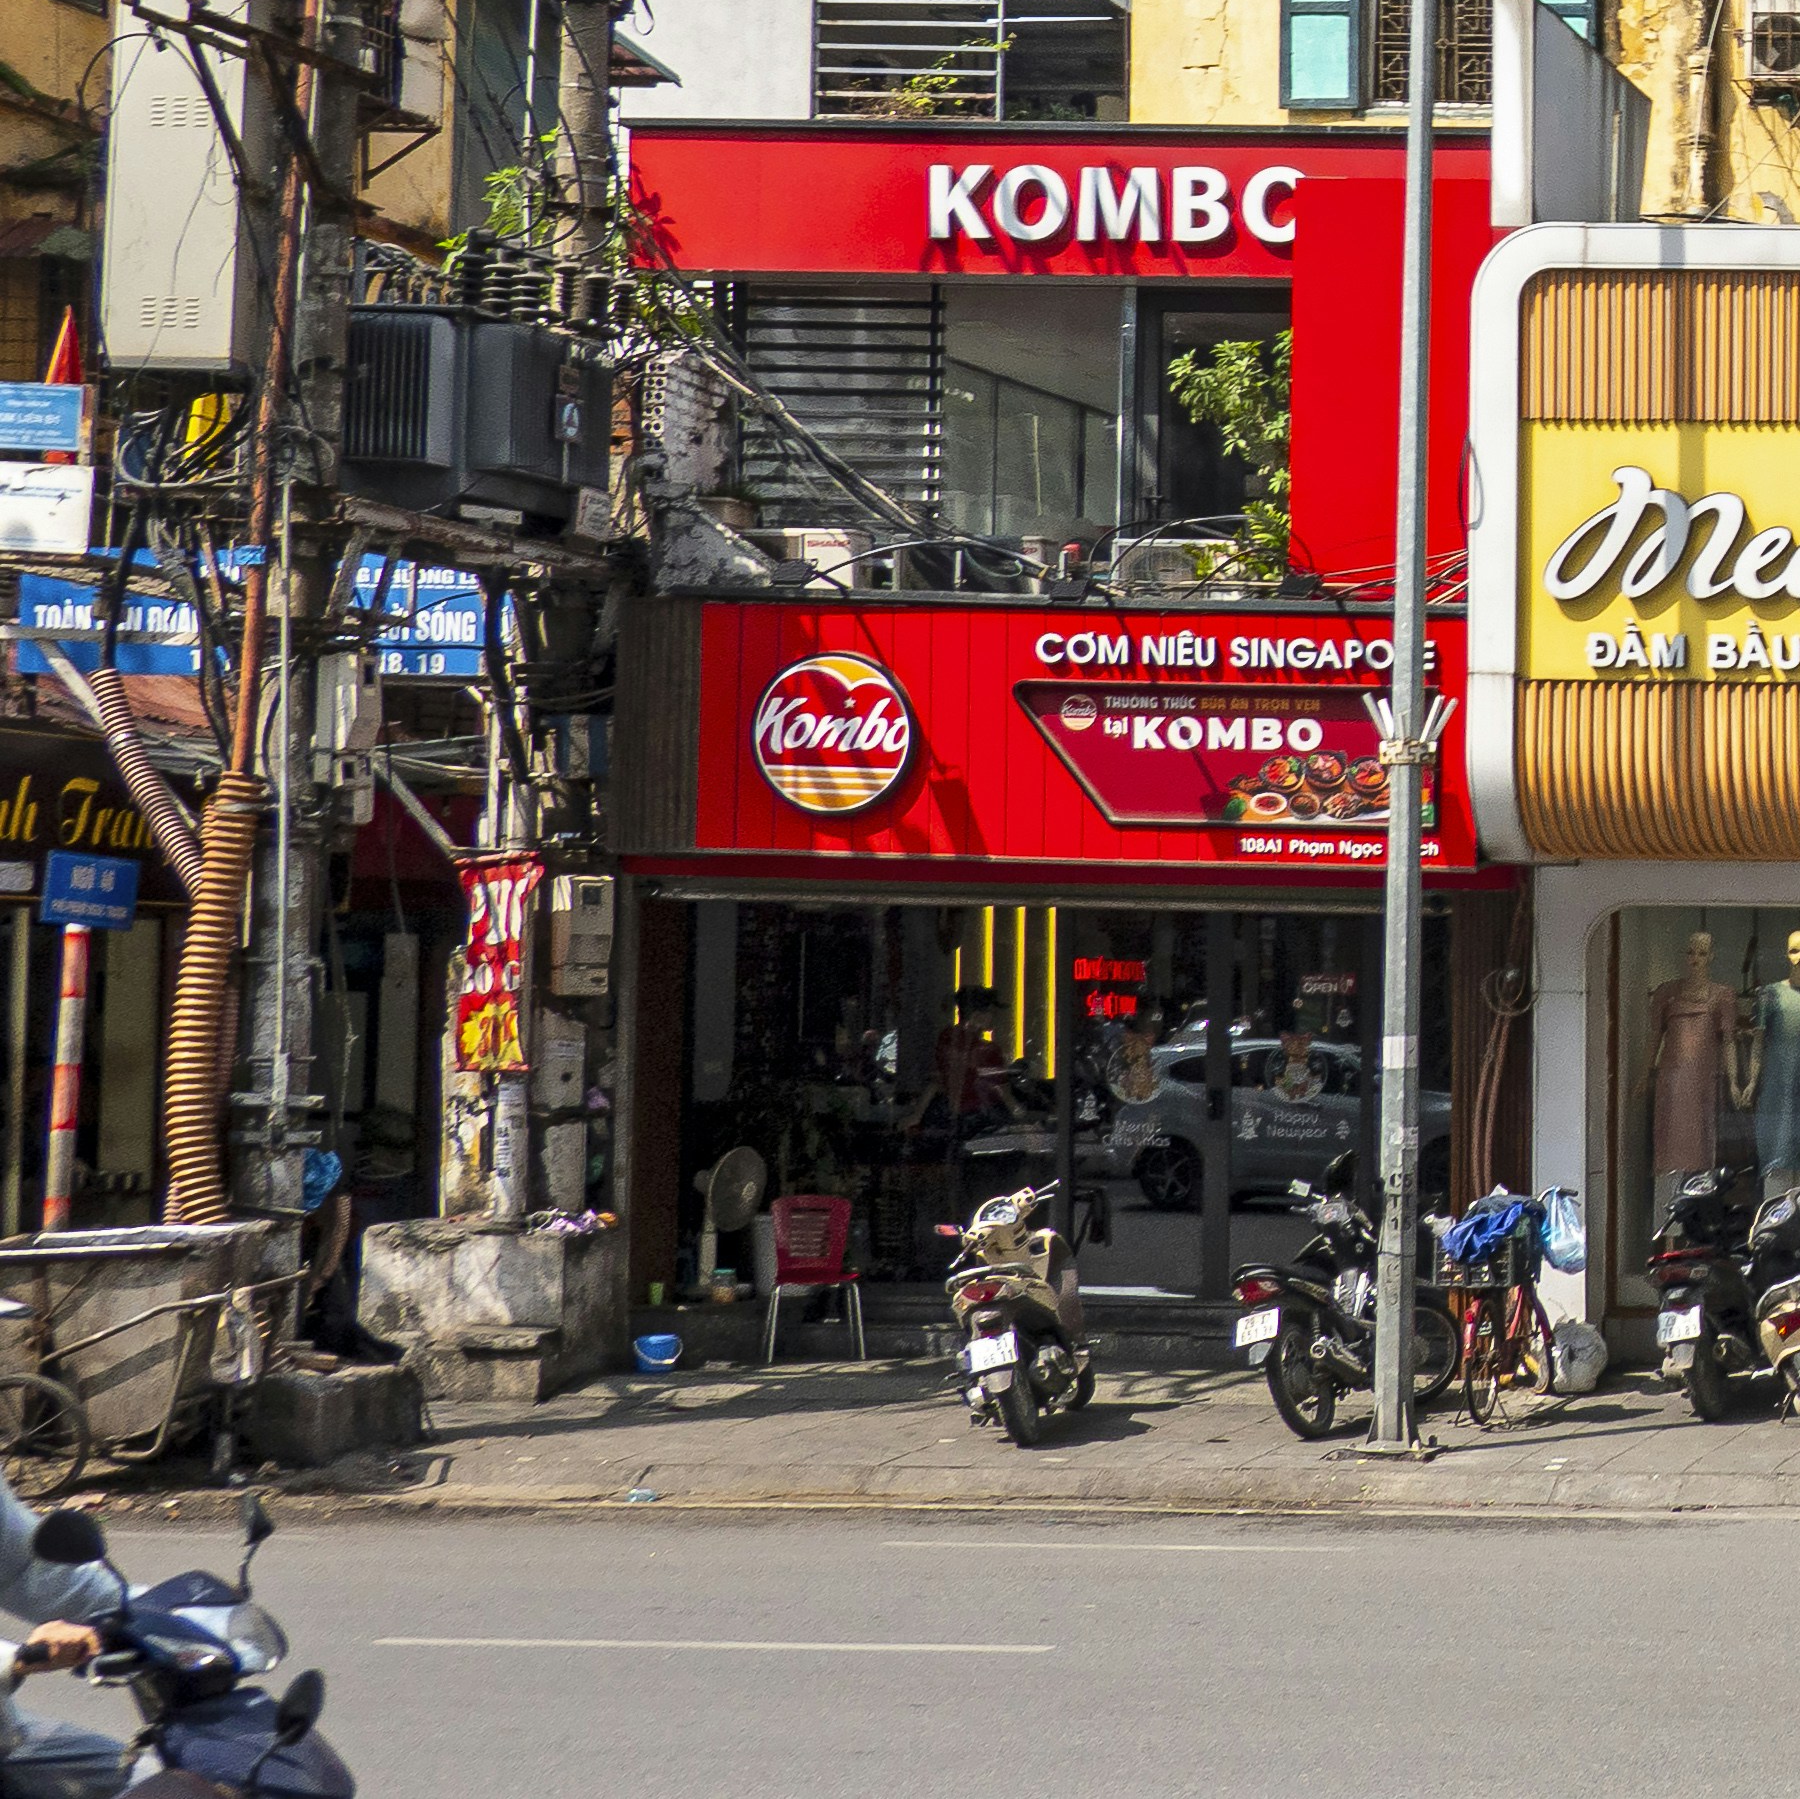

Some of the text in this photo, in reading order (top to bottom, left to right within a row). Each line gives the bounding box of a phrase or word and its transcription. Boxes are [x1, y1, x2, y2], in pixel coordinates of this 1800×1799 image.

[415, 601, 478, 642] SỐNG
[1035, 629, 1437, 671] CƠM NIÊU SINGAPOE
[1585, 618, 1689, 670] ĐẦM
[416, 653, 446, 675] 19
[757, 697, 910, 755] Kombo
[1103, 715, 1324, 752] tại KOMBO
[1240, 837, 1383, 860] 108A1 Phạm Ngọc
[1272, 1109, 1320, 1128] Happy
